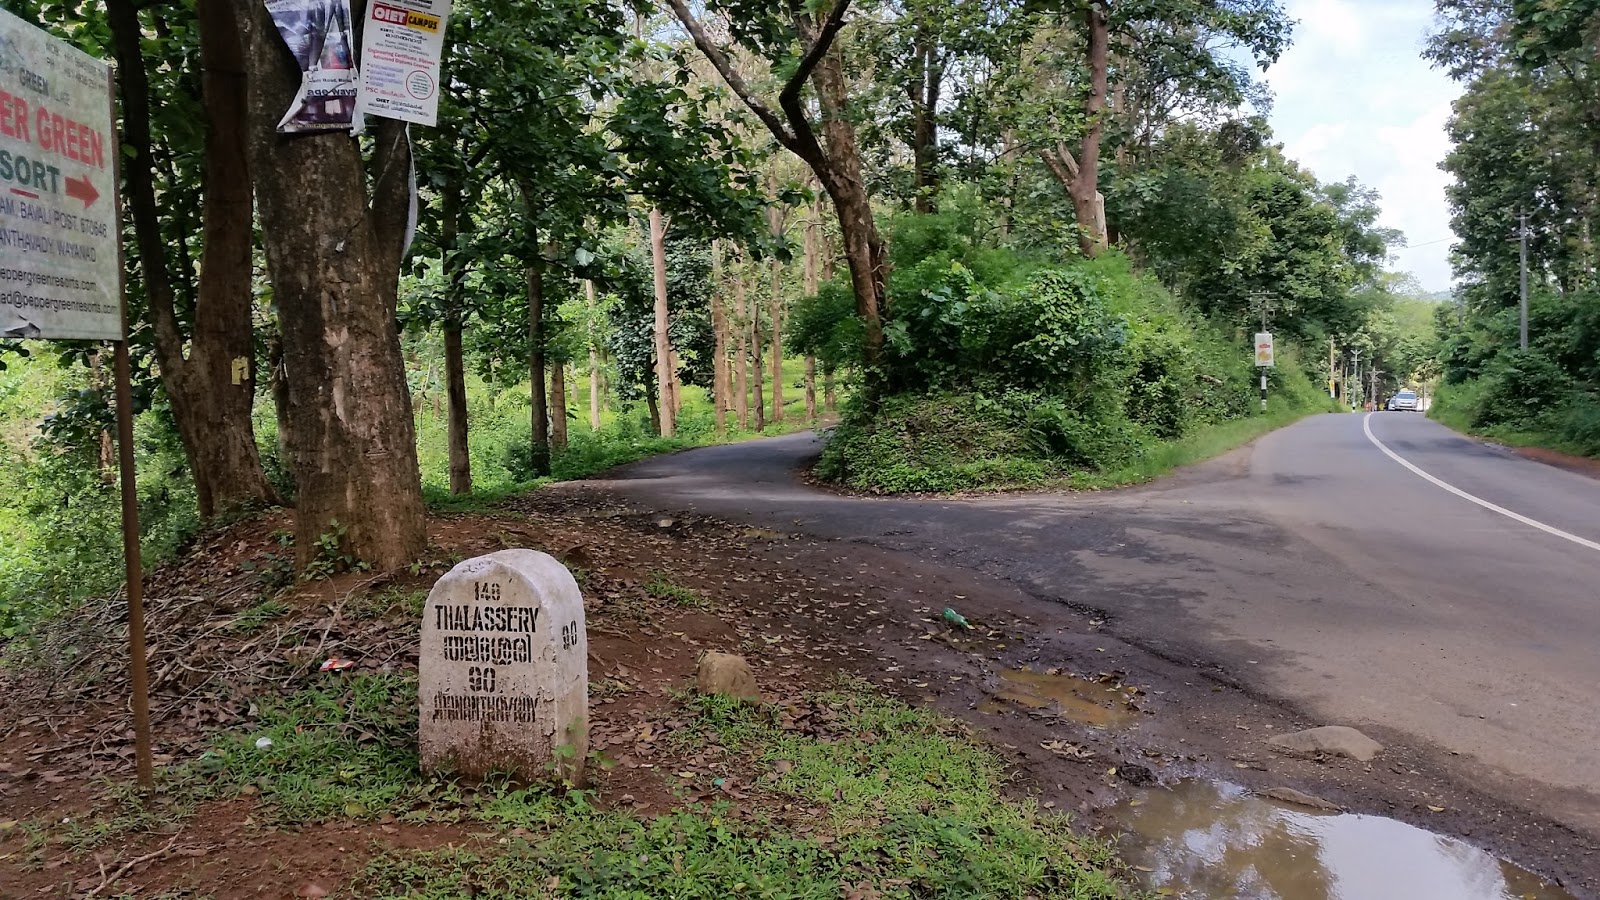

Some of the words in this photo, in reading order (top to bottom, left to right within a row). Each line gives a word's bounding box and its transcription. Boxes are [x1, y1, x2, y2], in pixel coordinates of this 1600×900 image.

[374, 7, 407, 23] OIET
[408, 15, 438, 30] CAMPUS
[20, 67, 49, 96] GREEN
[365, 86, 379, 94] PSC
[36, 105, 104, 170] GREEN
[21, 201, 52, 225] BAVALI
[57, 240, 97, 263] WAYANAD
[435, 605, 539, 633] THALASSERY
[468, 666, 496, 693] 90
